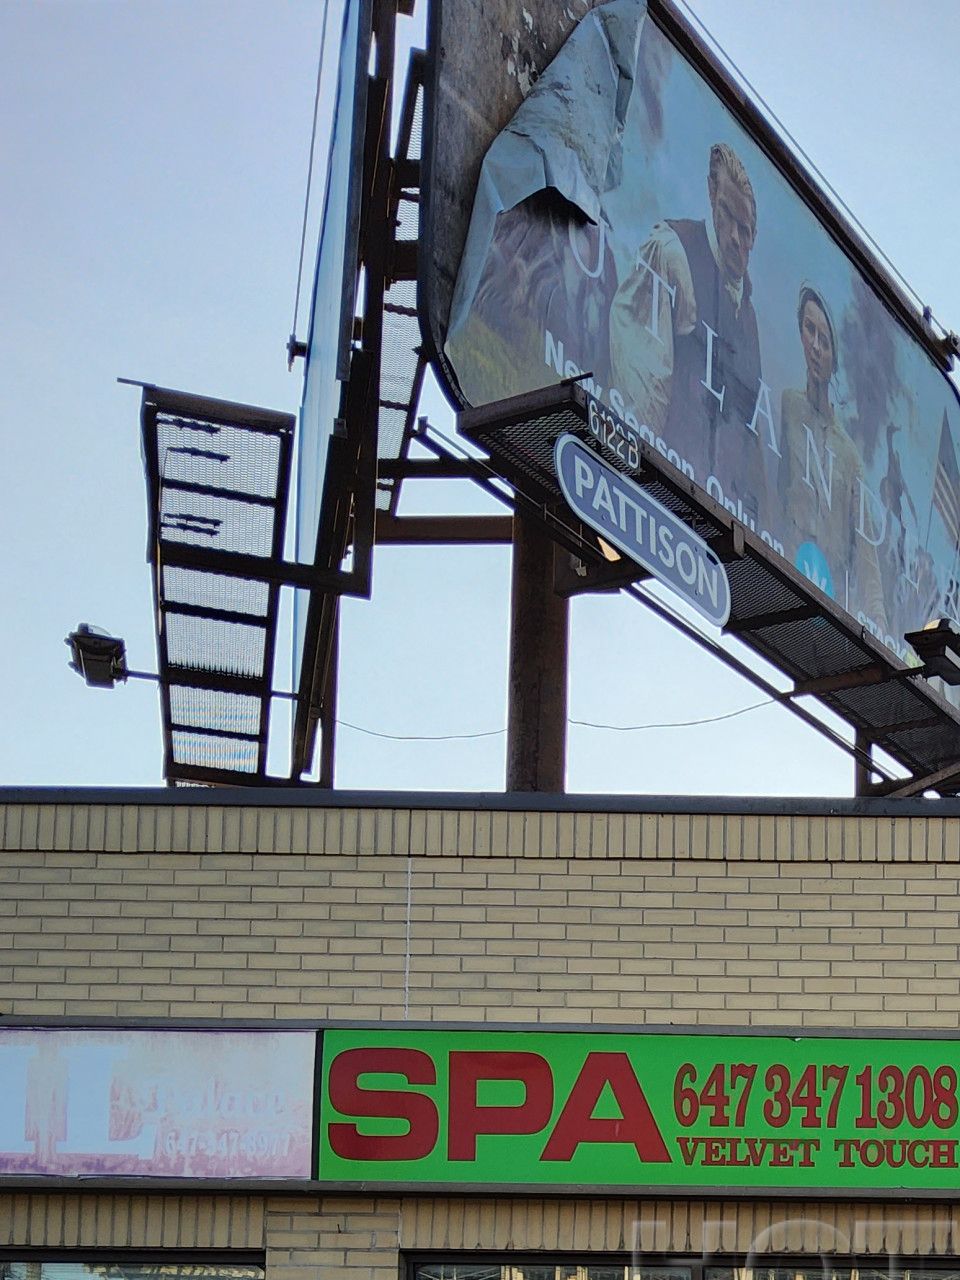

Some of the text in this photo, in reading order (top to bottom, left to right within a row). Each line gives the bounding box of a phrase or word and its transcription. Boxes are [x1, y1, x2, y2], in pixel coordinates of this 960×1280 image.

[574, 454, 718, 609] PATTISON
[328, 1047, 672, 1162] SPA
[674, 1062, 960, 1130] 647 347 1308
[676, 1136, 960, 1169] VELVET TOUCH
